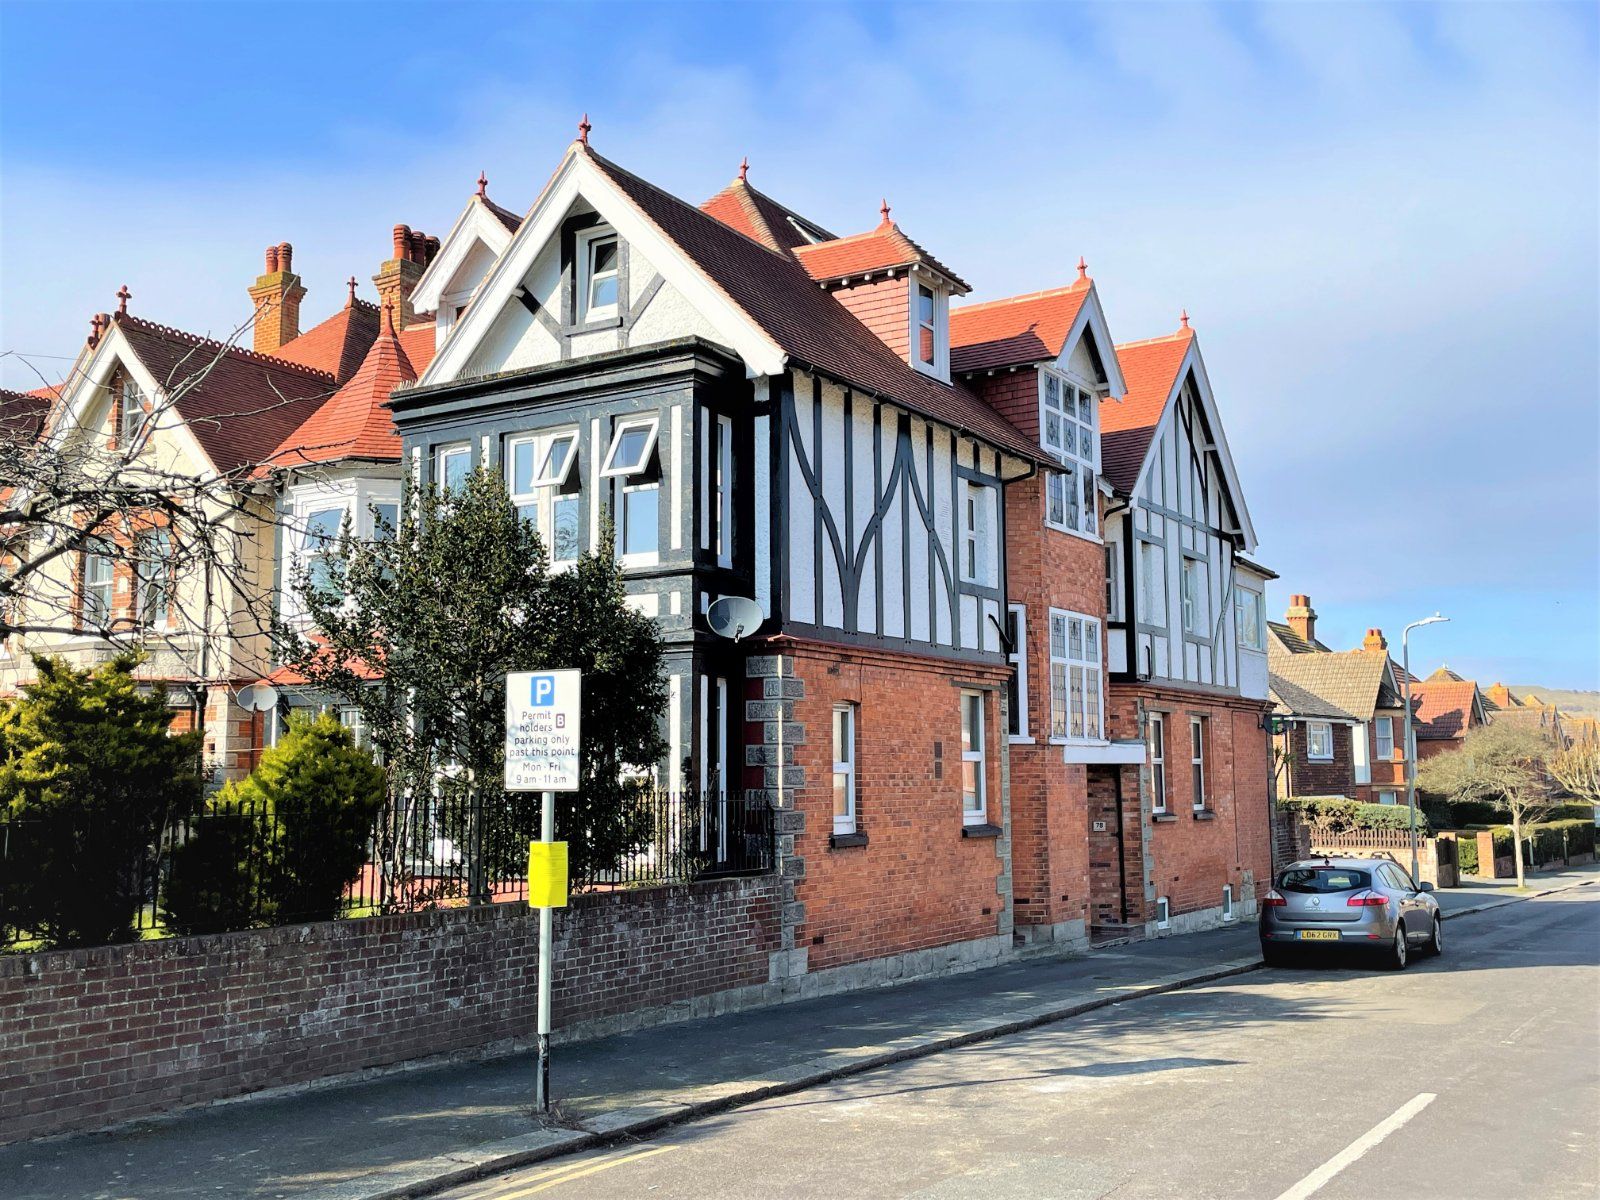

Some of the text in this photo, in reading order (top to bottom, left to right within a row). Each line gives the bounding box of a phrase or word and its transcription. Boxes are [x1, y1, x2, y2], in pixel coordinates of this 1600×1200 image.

[536, 679, 552, 704] P
[522, 711, 551, 720] Permit
[556, 714, 565, 727] B
[519, 723, 553, 732] holders
[514, 735, 570, 745] parking only
[509, 747, 575, 757] past this point
[522, 762, 541, 771] Mon
[549, 762, 561, 770] Fri
